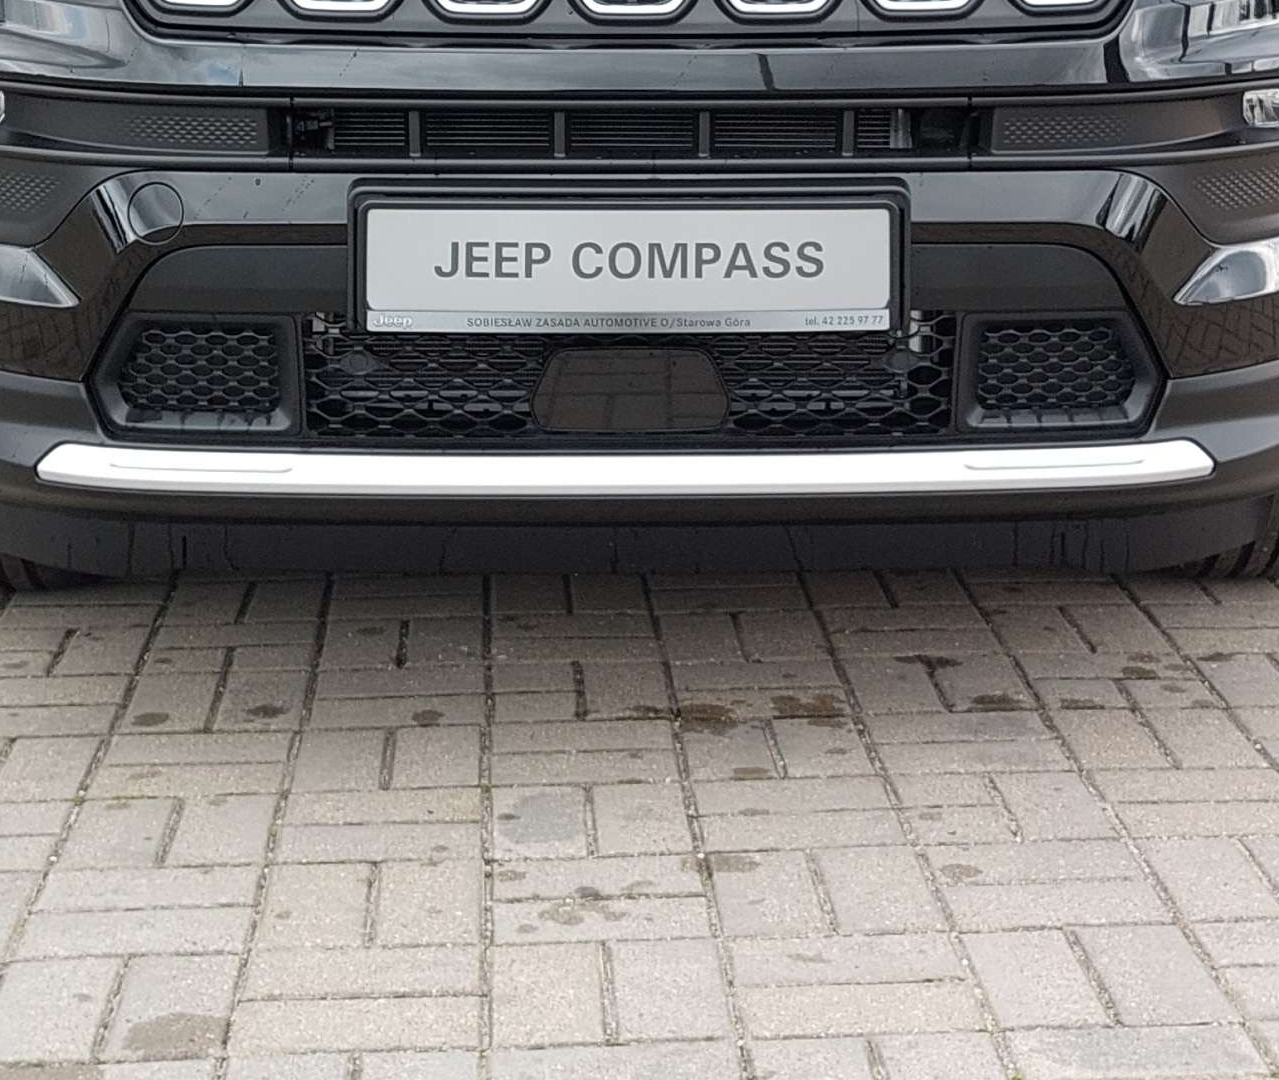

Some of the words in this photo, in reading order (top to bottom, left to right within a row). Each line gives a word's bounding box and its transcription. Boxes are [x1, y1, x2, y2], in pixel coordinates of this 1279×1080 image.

[433, 240, 552, 280] JEEP
[571, 240, 826, 280] COMPASS
[372, 313, 415, 330] Jeep
[535, 317, 581, 328] ZASADA
[583, 317, 658, 328] AUTOMOTIVE
[821, 315, 835, 326] 42
[871, 315, 884, 325] 77
